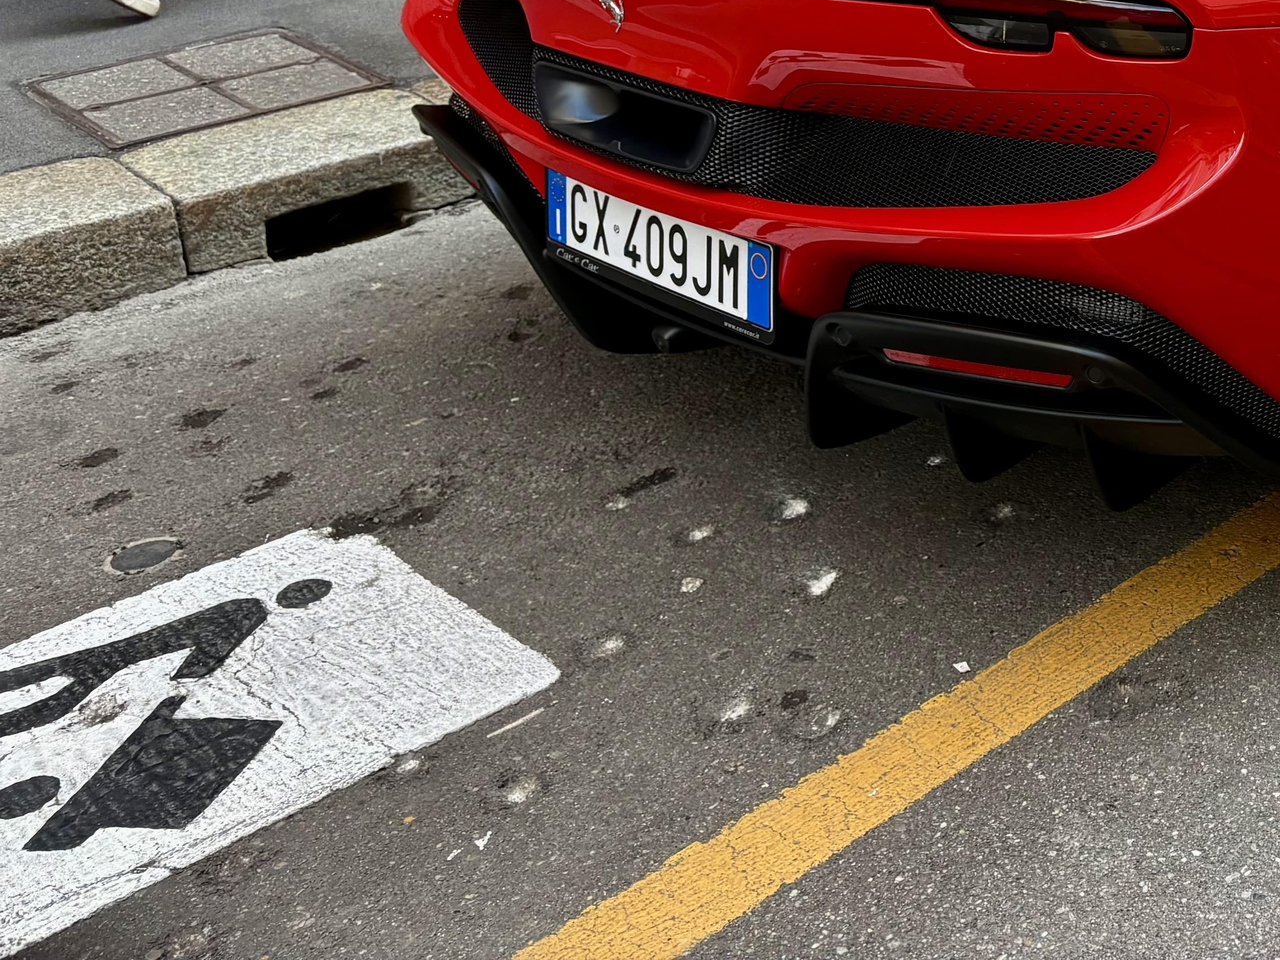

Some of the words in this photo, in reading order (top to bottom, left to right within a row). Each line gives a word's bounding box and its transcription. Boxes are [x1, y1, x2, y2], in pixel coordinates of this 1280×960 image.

[571, 184, 609, 256] GX
[624, 208, 739, 310] 409JM
[580, 259, 599, 274] Car
